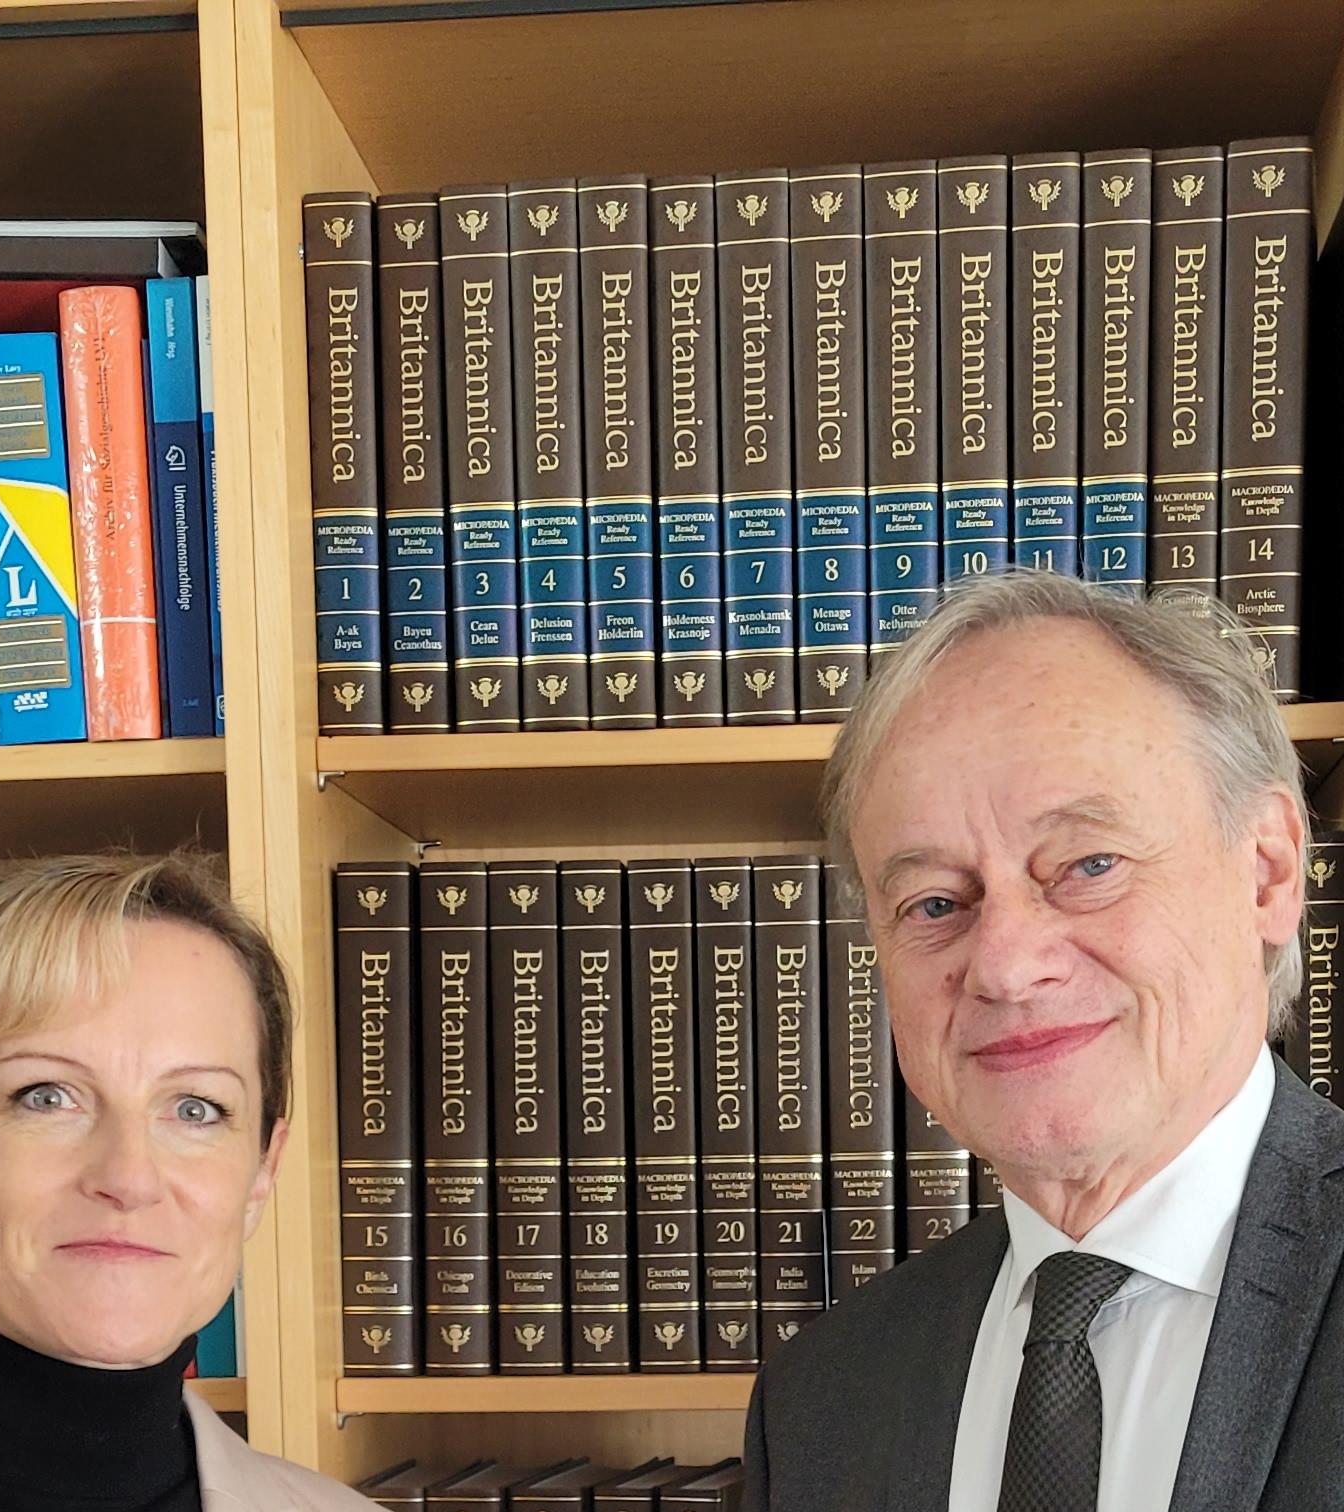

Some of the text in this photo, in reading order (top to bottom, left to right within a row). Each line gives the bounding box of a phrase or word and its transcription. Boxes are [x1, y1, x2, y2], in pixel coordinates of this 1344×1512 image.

[1103, 246, 1136, 450] Britannica
[1172, 244, 1207, 449] Britannica
[1250, 235, 1287, 443] Britannica
[815, 261, 848, 462] Britannica
[890, 256, 922, 459] Britannica
[961, 252, 993, 455] Britannica
[1031, 249, 1063, 453] Britannica
[532, 274, 565, 474] Britannica
[602, 270, 635, 471] Britannica
[670, 270, 704, 470] Britannica
[741, 264, 774, 466] Britannica
[328, 287, 361, 483] Britannica
[399, 287, 432, 483] Britannica
[462, 279, 496, 478] Britannica
[172, 484, 191, 611] Unternehmensnachfolge
[1101, 546, 1128, 570] 12
[1171, 545, 1196, 568] 13
[1248, 538, 1275, 561] 14
[824, 558, 839, 581] 8
[896, 554, 912, 578] 9
[962, 551, 988, 575] 10
[1033, 549, 1054, 572] 11
[475, 573, 490, 595] 3
[541, 569, 556, 592] 4
[612, 566, 627, 589] 5
[679, 565, 695, 588] 6
[750, 561, 765, 584] 7
[341, 578, 351, 600] 1
[408, 578, 423, 601] 2
[1246, 588, 1276, 600] Arctic
[606, 615, 634, 625] Freon
[1237, 602, 1285, 615] Biosphere
[530, 617, 573, 629] Delusion
[598, 627, 644, 640] Holderlin
[739, 623, 782, 636] Menadra
[815, 620, 849, 632] Ottawa
[334, 638, 362, 651] Bayes
[1307, 923, 1340, 1098] Britannic
[360, 950, 393, 1137] Britannica
[440, 949, 473, 1137] Britannica
[513, 949, 545, 1136] Britannica
[580, 949, 613, 1135] Britannica
[649, 947, 682, 1133] Britannica
[713, 945, 747, 1132] Britannica
[776, 945, 809, 1132] Britannica
[847, 942, 877, 1130] Britannica
[365, 1226, 388, 1247] 15
[443, 1225, 467, 1247] 16
[516, 1224, 539, 1245] 17
[584, 1223, 608, 1245] 18
[654, 1222, 679, 1244] 19
[716, 1220, 745, 1243] 20
[778, 1221, 802, 1243] 21
[849, 1219, 876, 1241] 22
